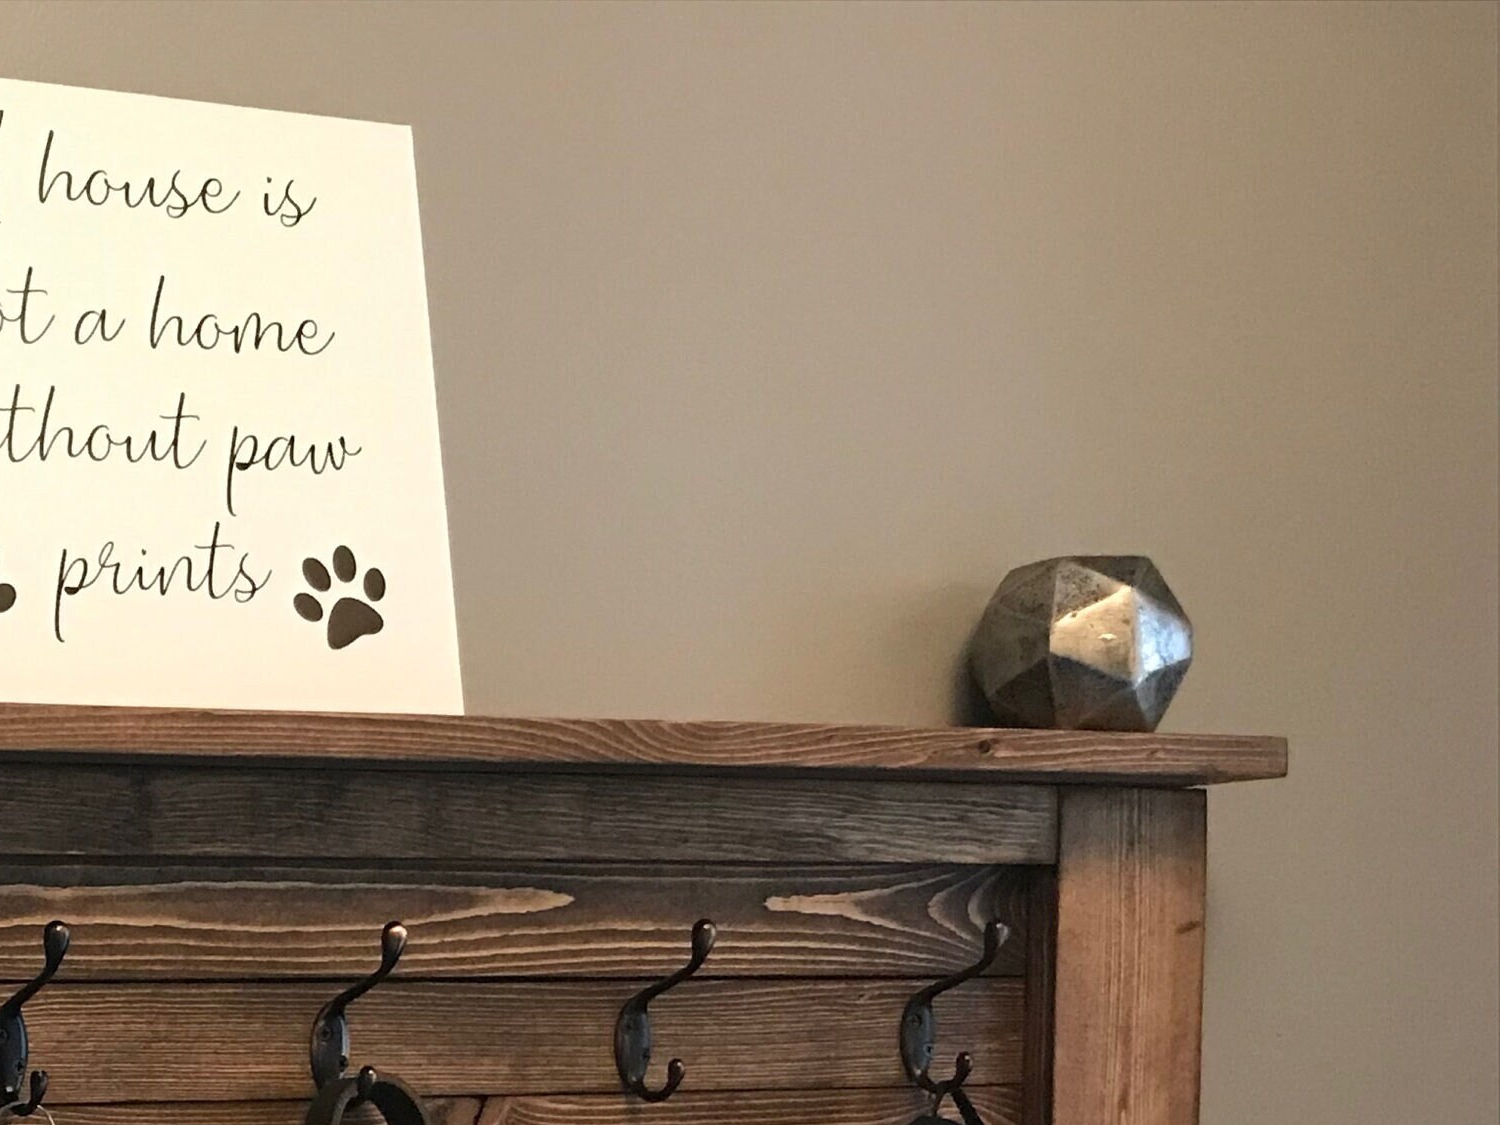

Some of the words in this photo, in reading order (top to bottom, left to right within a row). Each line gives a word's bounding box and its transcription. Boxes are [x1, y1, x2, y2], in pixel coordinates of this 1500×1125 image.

[37, 129, 242, 220] house
[263, 176, 318, 228] is
[74, 308, 126, 346] a
[149, 274, 336, 356] home
[226, 425, 364, 518] paw
[54, 520, 273, 644] prints
